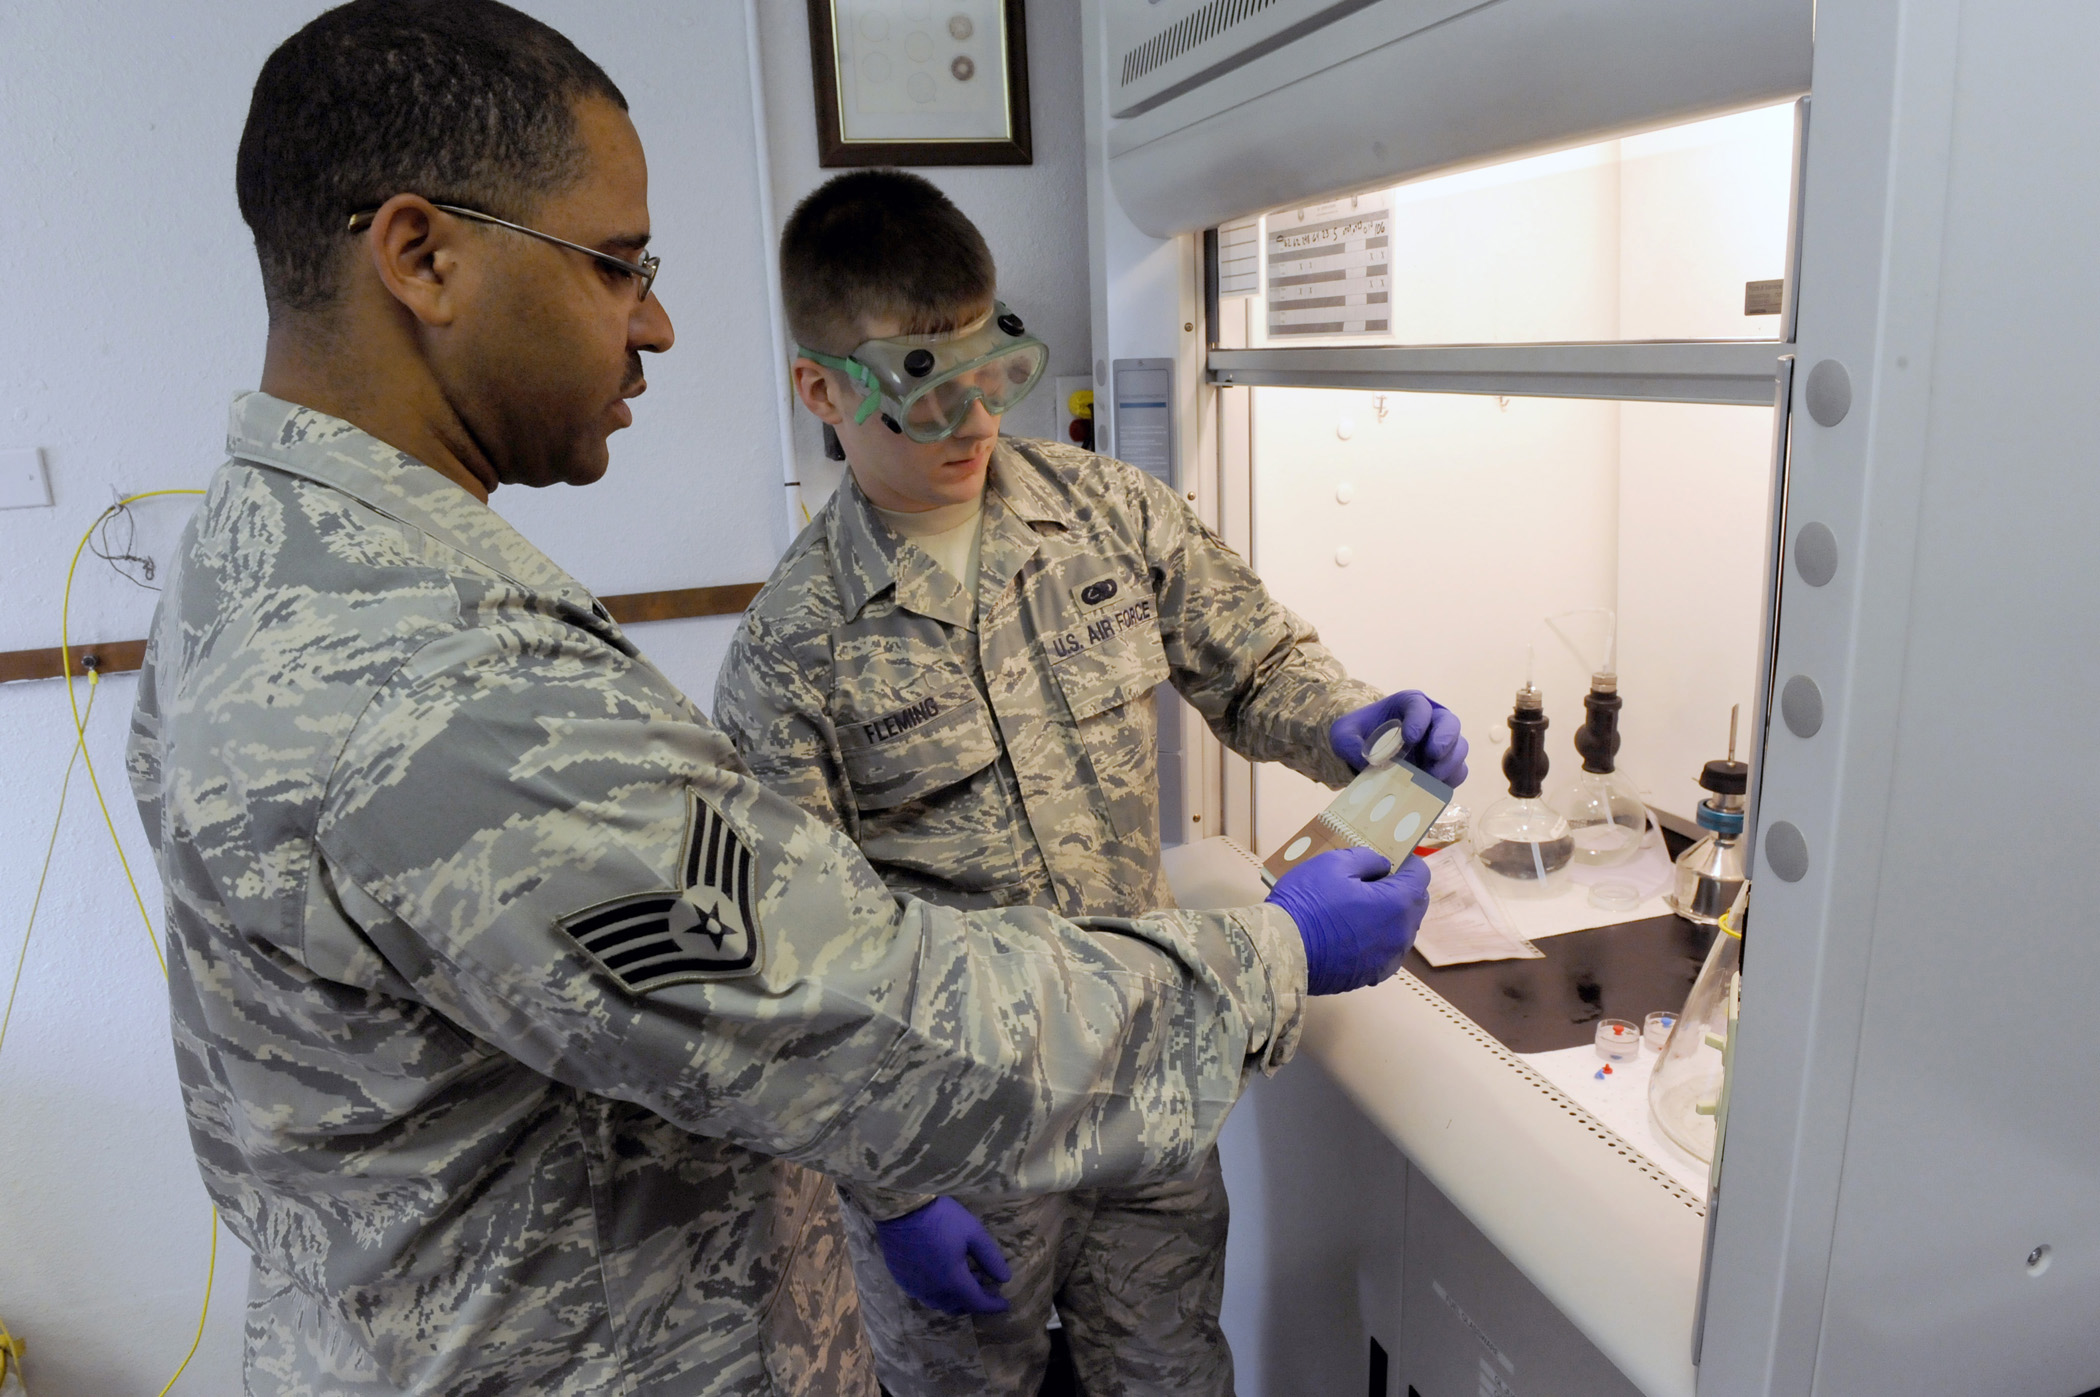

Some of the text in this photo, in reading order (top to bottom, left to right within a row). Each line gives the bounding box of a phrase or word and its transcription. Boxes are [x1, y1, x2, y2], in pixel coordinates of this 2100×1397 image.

[1052, 600, 1151, 658] U.S. AIR FORCE
[862, 696, 939, 745] FLEMING
